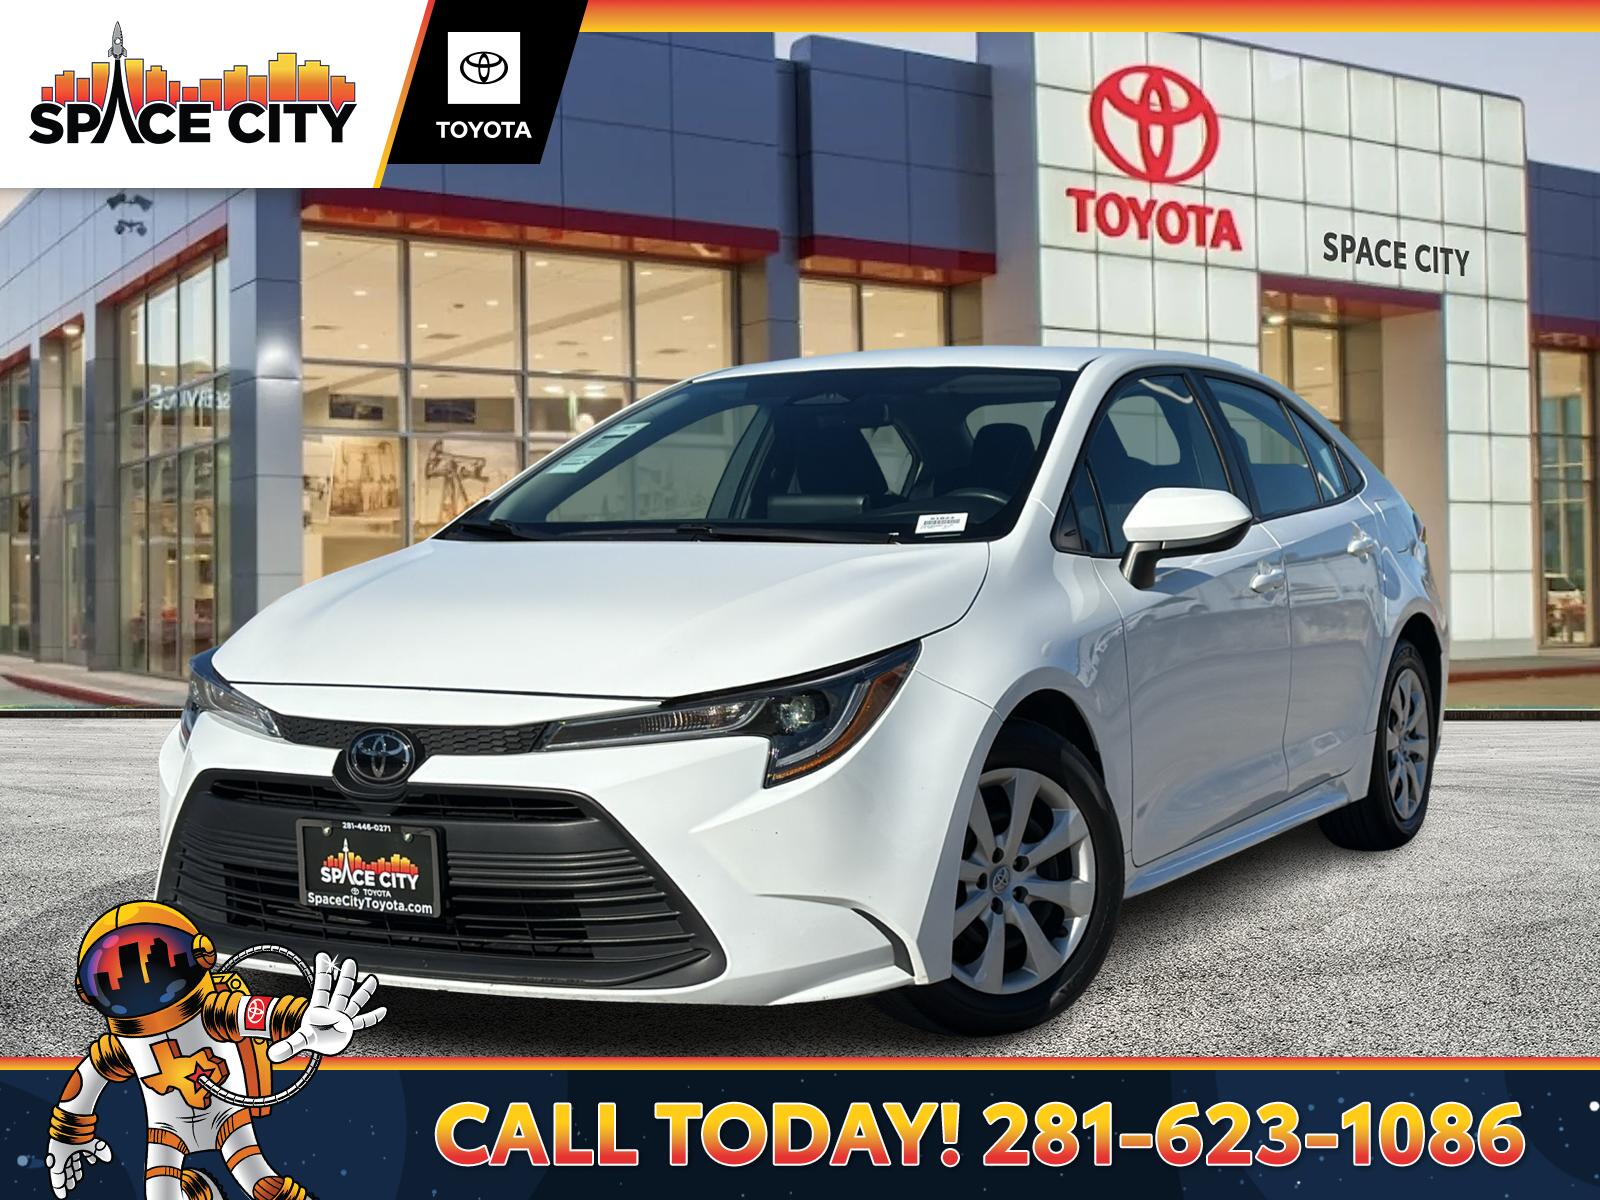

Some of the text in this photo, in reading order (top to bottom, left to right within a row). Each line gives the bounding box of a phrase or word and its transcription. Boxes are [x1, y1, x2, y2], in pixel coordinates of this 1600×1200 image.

[1066, 187, 1242, 252] TOYOTA
[1322, 231, 1471, 277] SPACE CITY
[320, 866, 419, 889] SPACE CITY
[308, 892, 433, 914] SpaceCityToyota.com
[363, 888, 392, 898] TOYOTA
